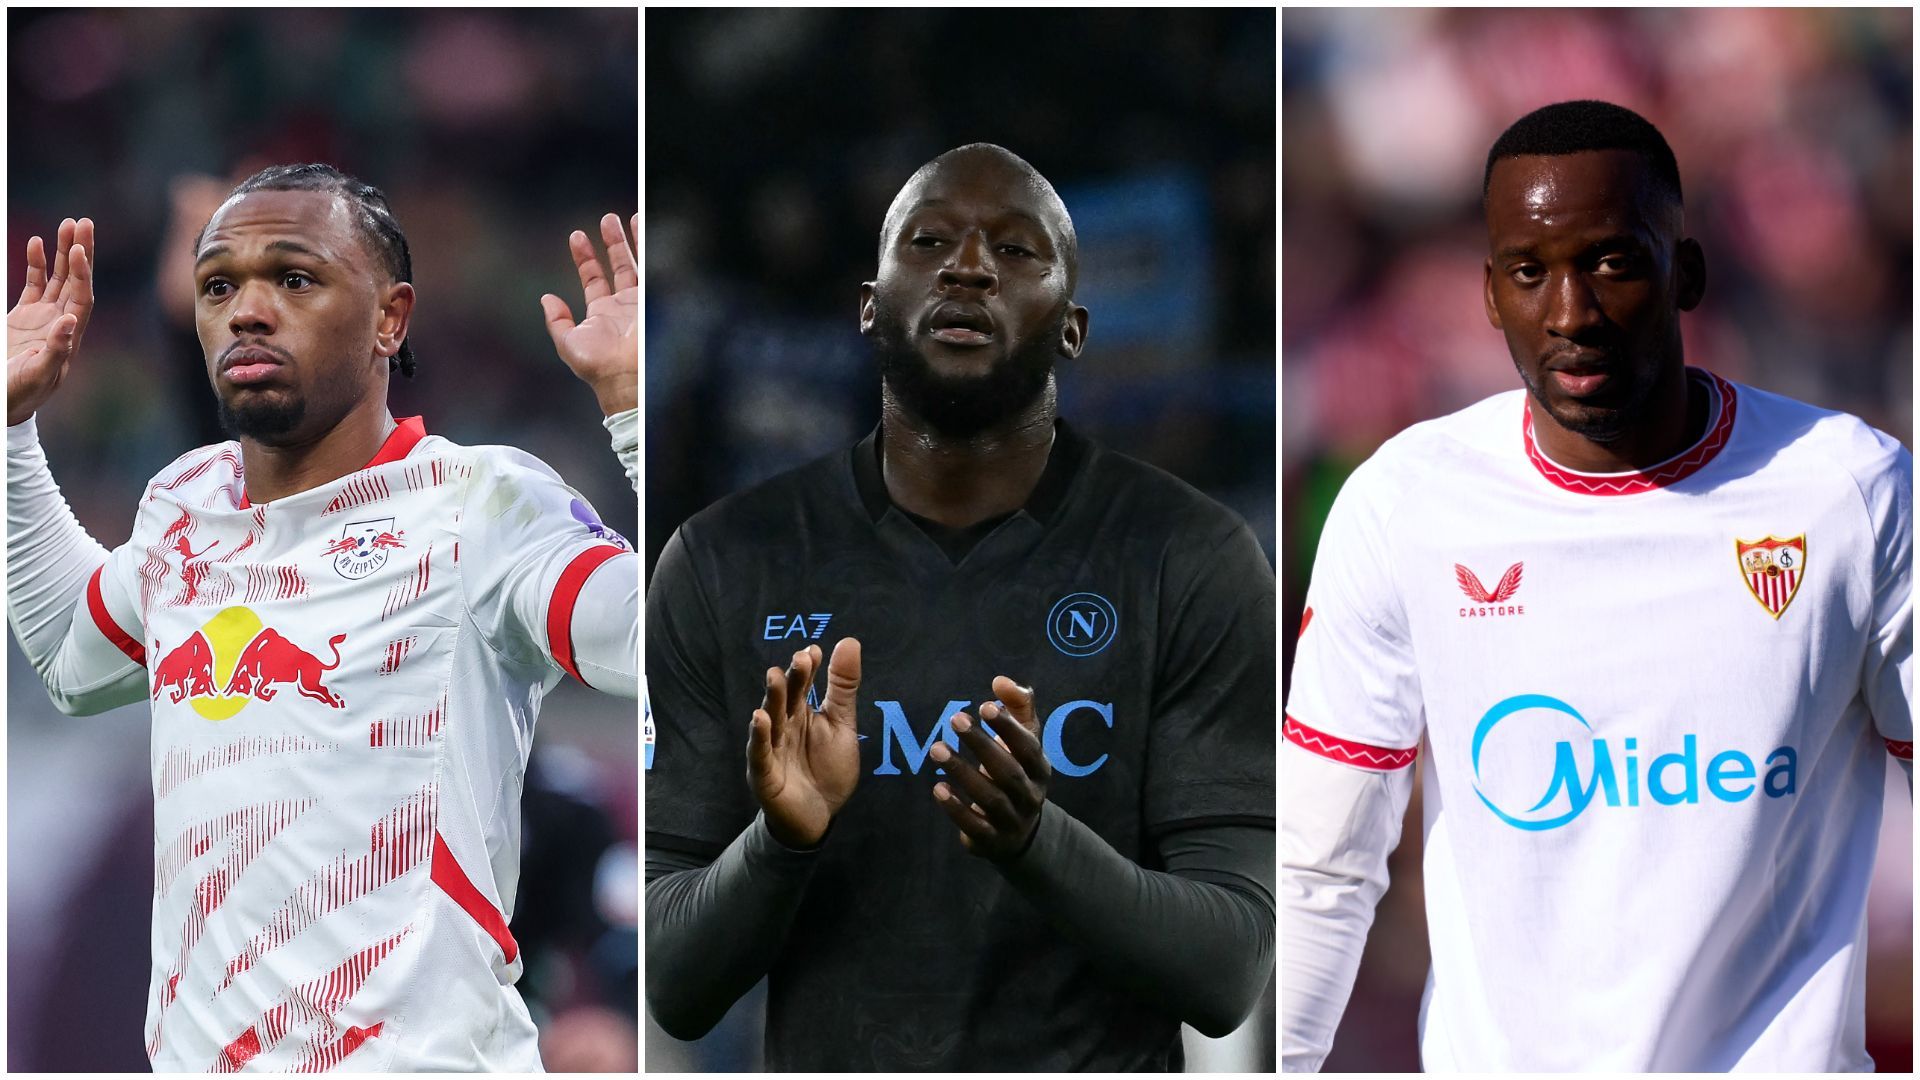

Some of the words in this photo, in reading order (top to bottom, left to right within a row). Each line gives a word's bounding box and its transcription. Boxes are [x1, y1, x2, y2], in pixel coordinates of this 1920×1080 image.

[349, 553, 384, 575] LEIPZIG
[1066, 610, 1099, 638] N
[1459, 605, 1524, 617] CASTORE
[763, 613, 833, 640] EA7
[873, 700, 1114, 778] MC
[1471, 734, 1798, 831] Midea
